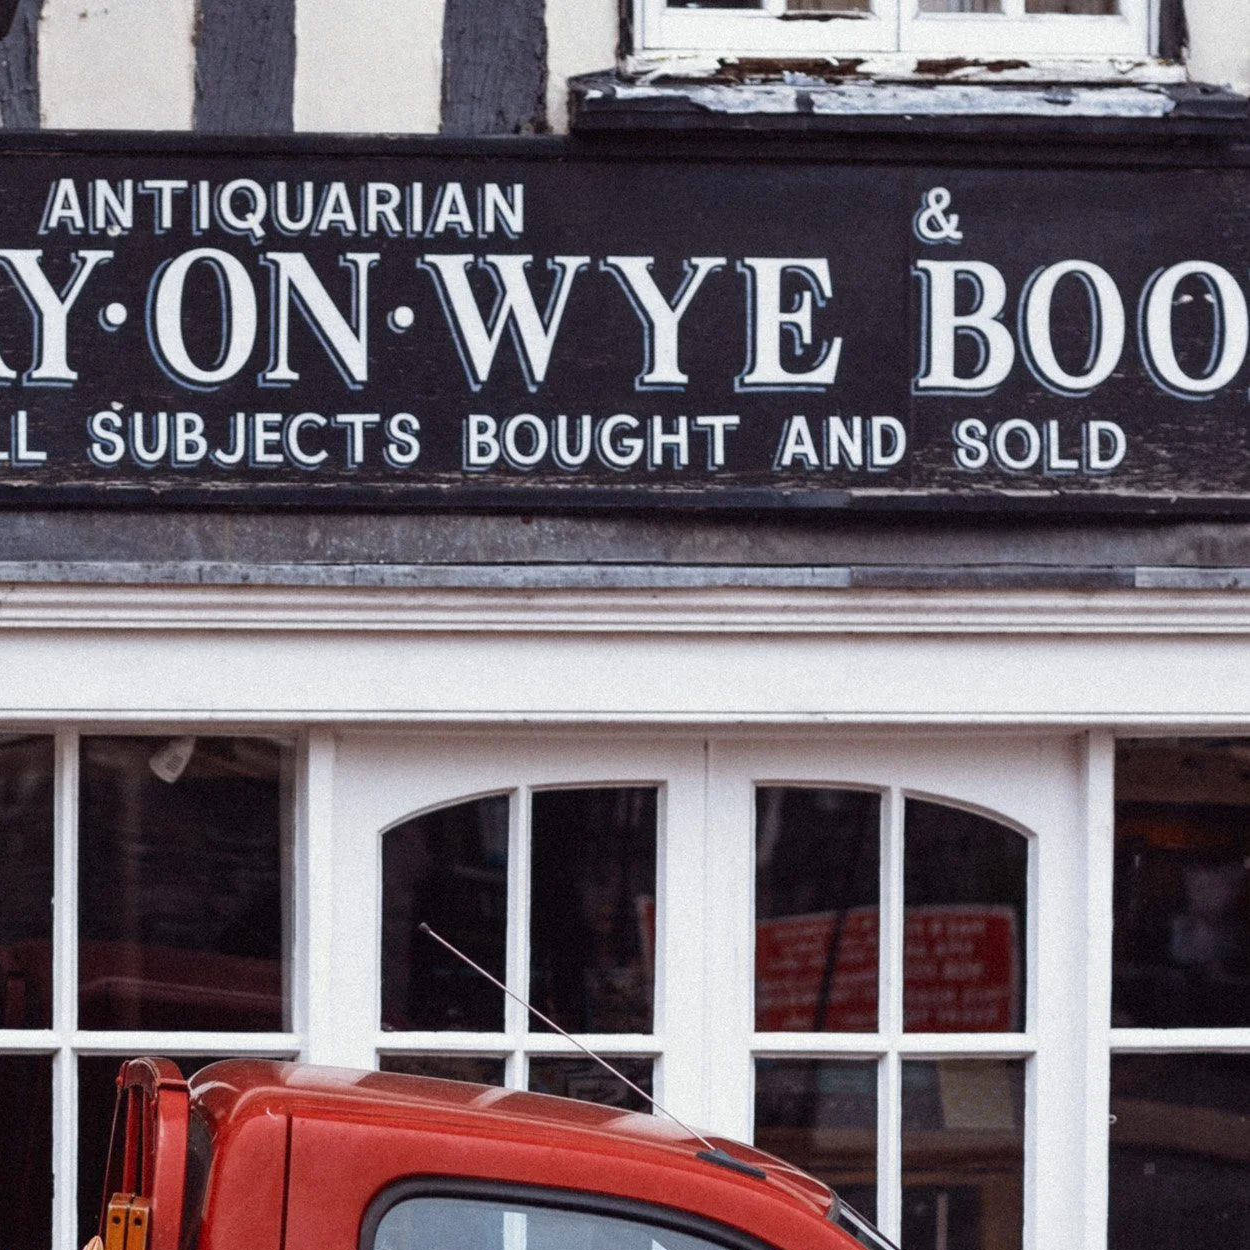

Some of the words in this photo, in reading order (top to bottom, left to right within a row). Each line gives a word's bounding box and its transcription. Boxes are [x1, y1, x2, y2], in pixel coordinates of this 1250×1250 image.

[40, 178, 525, 246] ANTIQUARIAN
[914, 186, 963, 244] &
[911, 258, 1250, 400] BOO
[87, 410, 421, 469] SUBJECTS
[462, 413, 740, 471] BOUGHT
[773, 415, 907, 471] AND
[953, 418, 1127, 475] SOLD
